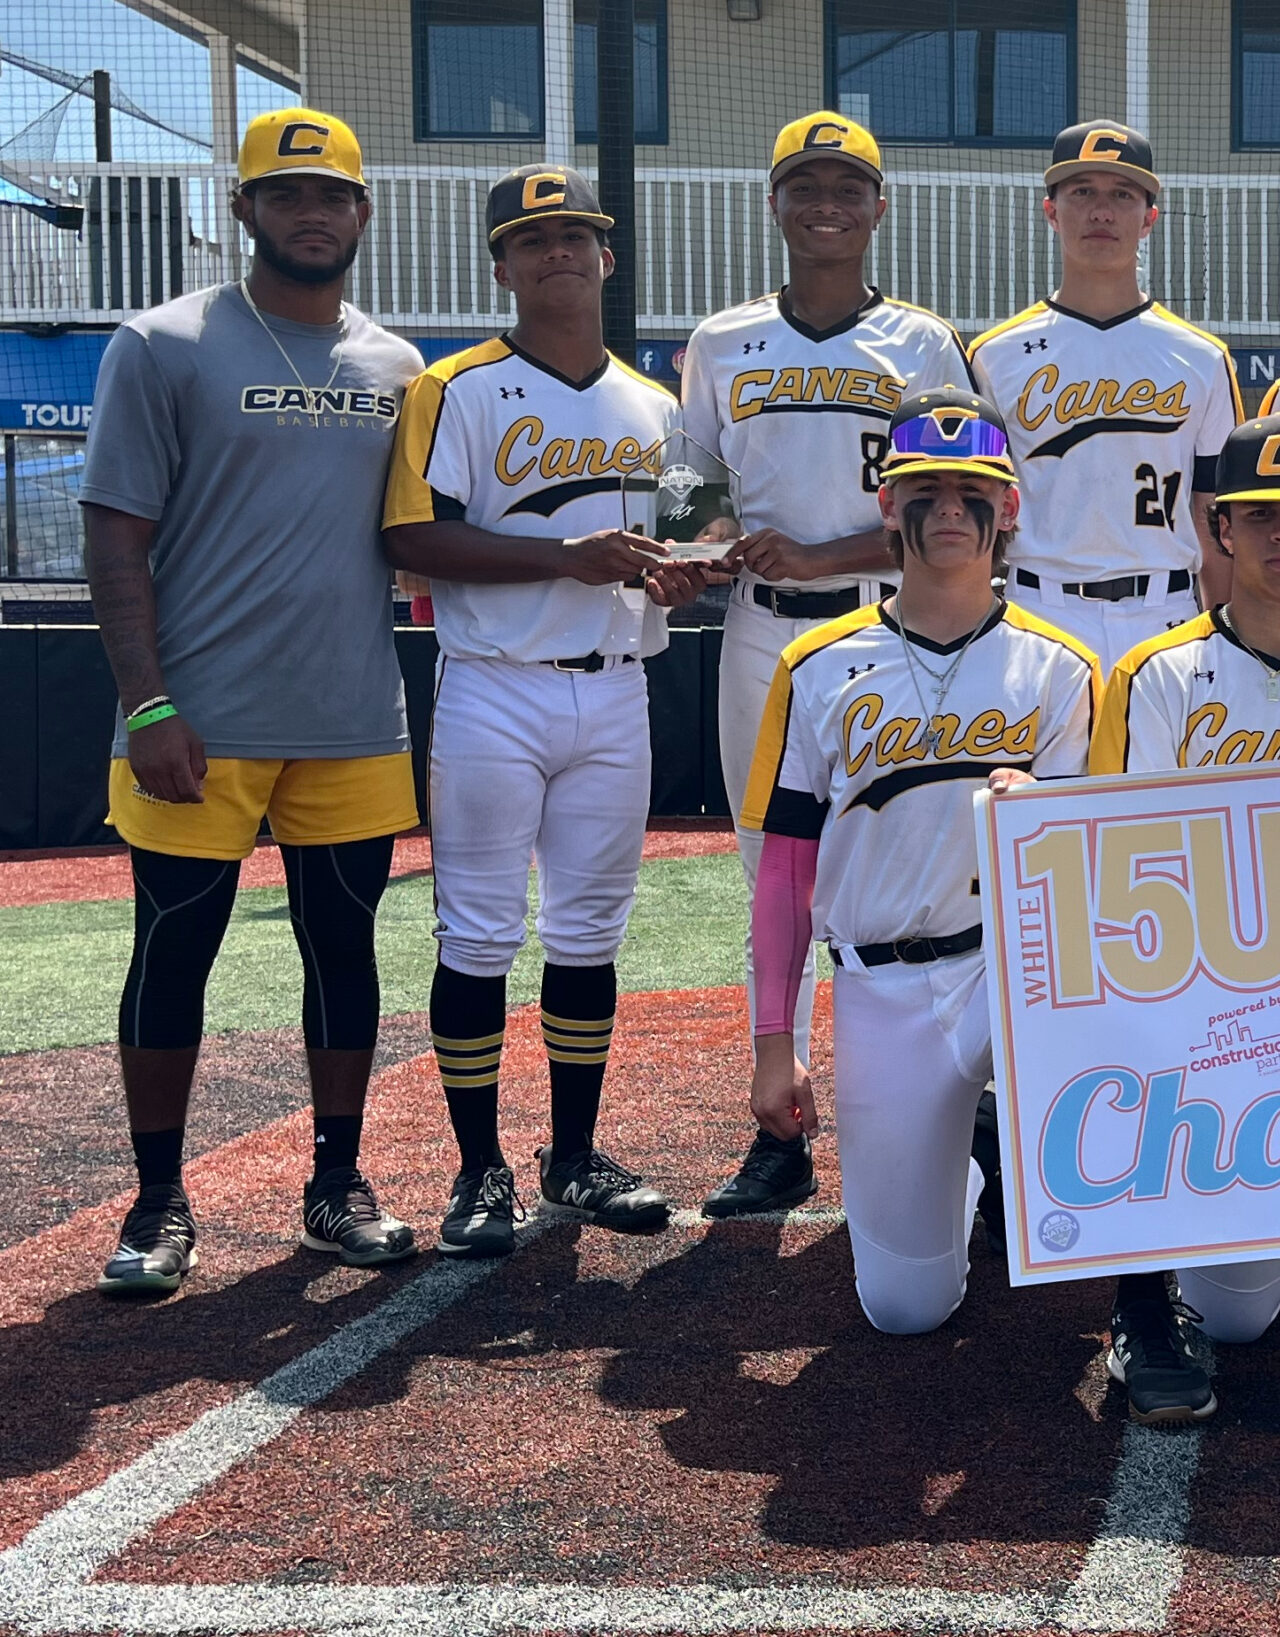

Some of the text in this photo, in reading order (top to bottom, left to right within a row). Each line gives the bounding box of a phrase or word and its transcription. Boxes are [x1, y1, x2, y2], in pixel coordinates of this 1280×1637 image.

[278, 122, 330, 156] C
[803, 122, 850, 150] C
[1078, 129, 1129, 163] C
[521, 172, 567, 210] C
[240, 384, 398, 421] CANES
[729, 367, 908, 423] CANES
[1016, 363, 1192, 431] Canes
[495, 415, 664, 486] Canes
[660, 477, 703, 487] NATION
[1133, 462, 1182, 532] 21
[841, 693, 1041, 778] Canes
[1017, 895, 1047, 1010] WHITE
[1208, 998, 1266, 1027] powered
